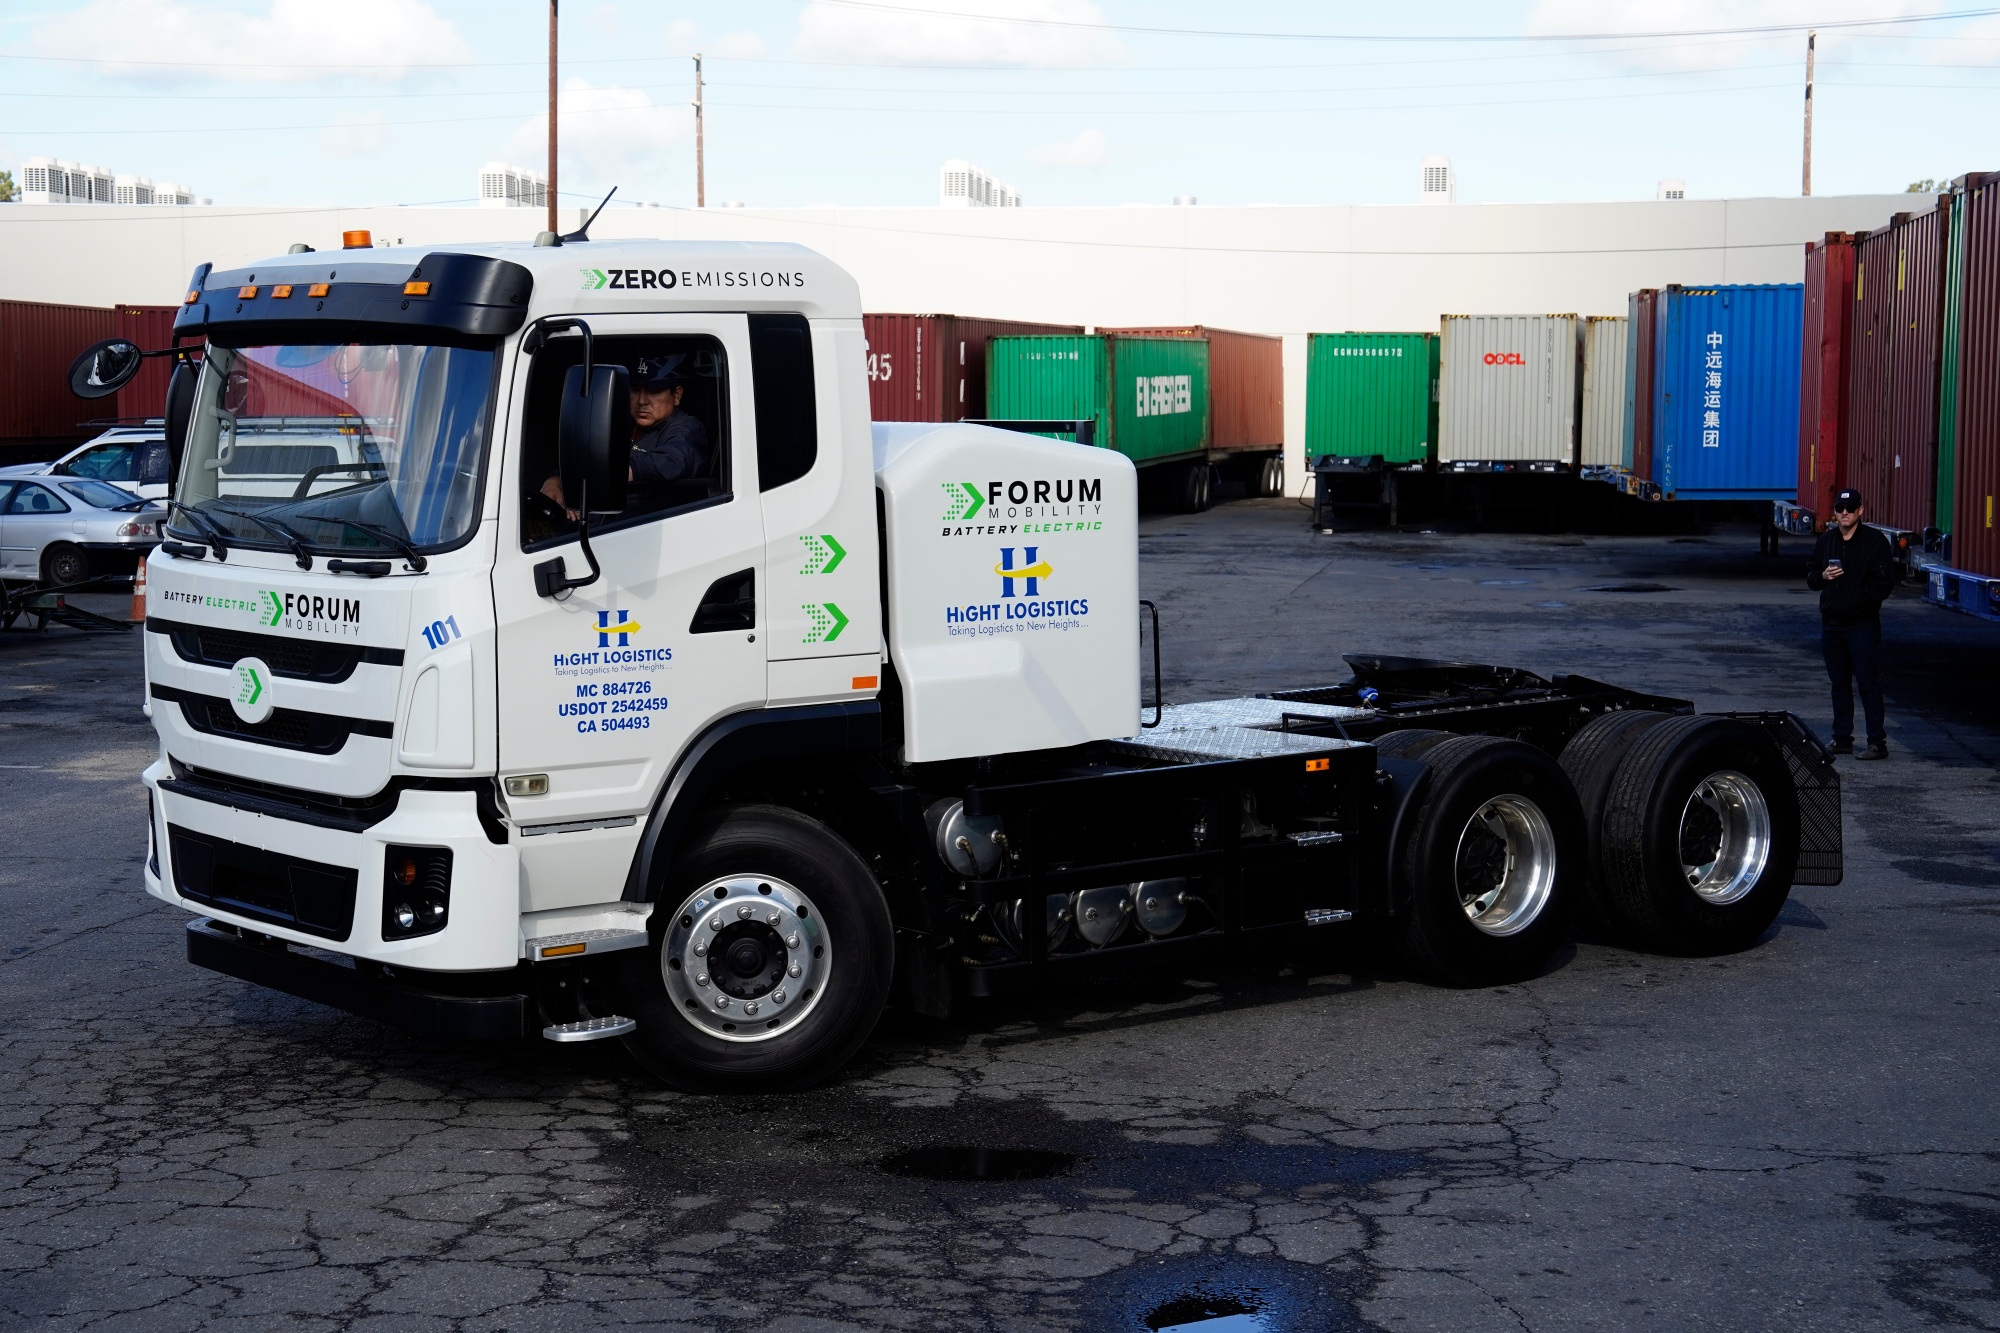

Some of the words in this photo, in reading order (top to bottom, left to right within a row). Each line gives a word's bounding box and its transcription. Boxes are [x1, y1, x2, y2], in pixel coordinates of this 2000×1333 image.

[607, 269, 677, 289] ZERO
[681, 271, 805, 287] EMISSIONS
[637, 357, 649, 374] LA
[867, 353, 892, 382] 45
[1483, 352, 1526, 366] OOCL
[1702, 331, 1723, 448] 中远海运集团
[988, 478, 1102, 505] FORUM
[988, 504, 1101, 519] MOBILITY
[941, 525, 1018, 537] BATTERY
[1023, 521, 1103, 534] ELECTRIC
[164, 590, 204, 605] BATTERY
[206, 596, 257, 612] ELECTRIC
[285, 593, 361, 623] FORUM
[1006, 598, 1089, 620] LOGISTICS
[285, 618, 360, 636] MOBILITY
[421, 614, 462, 650] 101
[947, 625, 976, 637] Taking
[978, 623, 1014, 636] Logistics
[1016, 623, 1025, 632] to
[1027, 621, 1047, 631] New
[603, 647, 673, 664] LOGISTICS
[555, 667, 579, 677] Taking
[580, 665, 610, 676] Logistics
[620, 664, 637, 672] New
[576, 684, 598, 698] MC
[602, 680, 652, 696] 884726
[558, 701, 608, 717] USDOT
[611, 697, 668, 714] 2542459
[577, 720, 597, 733] CA
[601, 716, 650, 732] 504493
